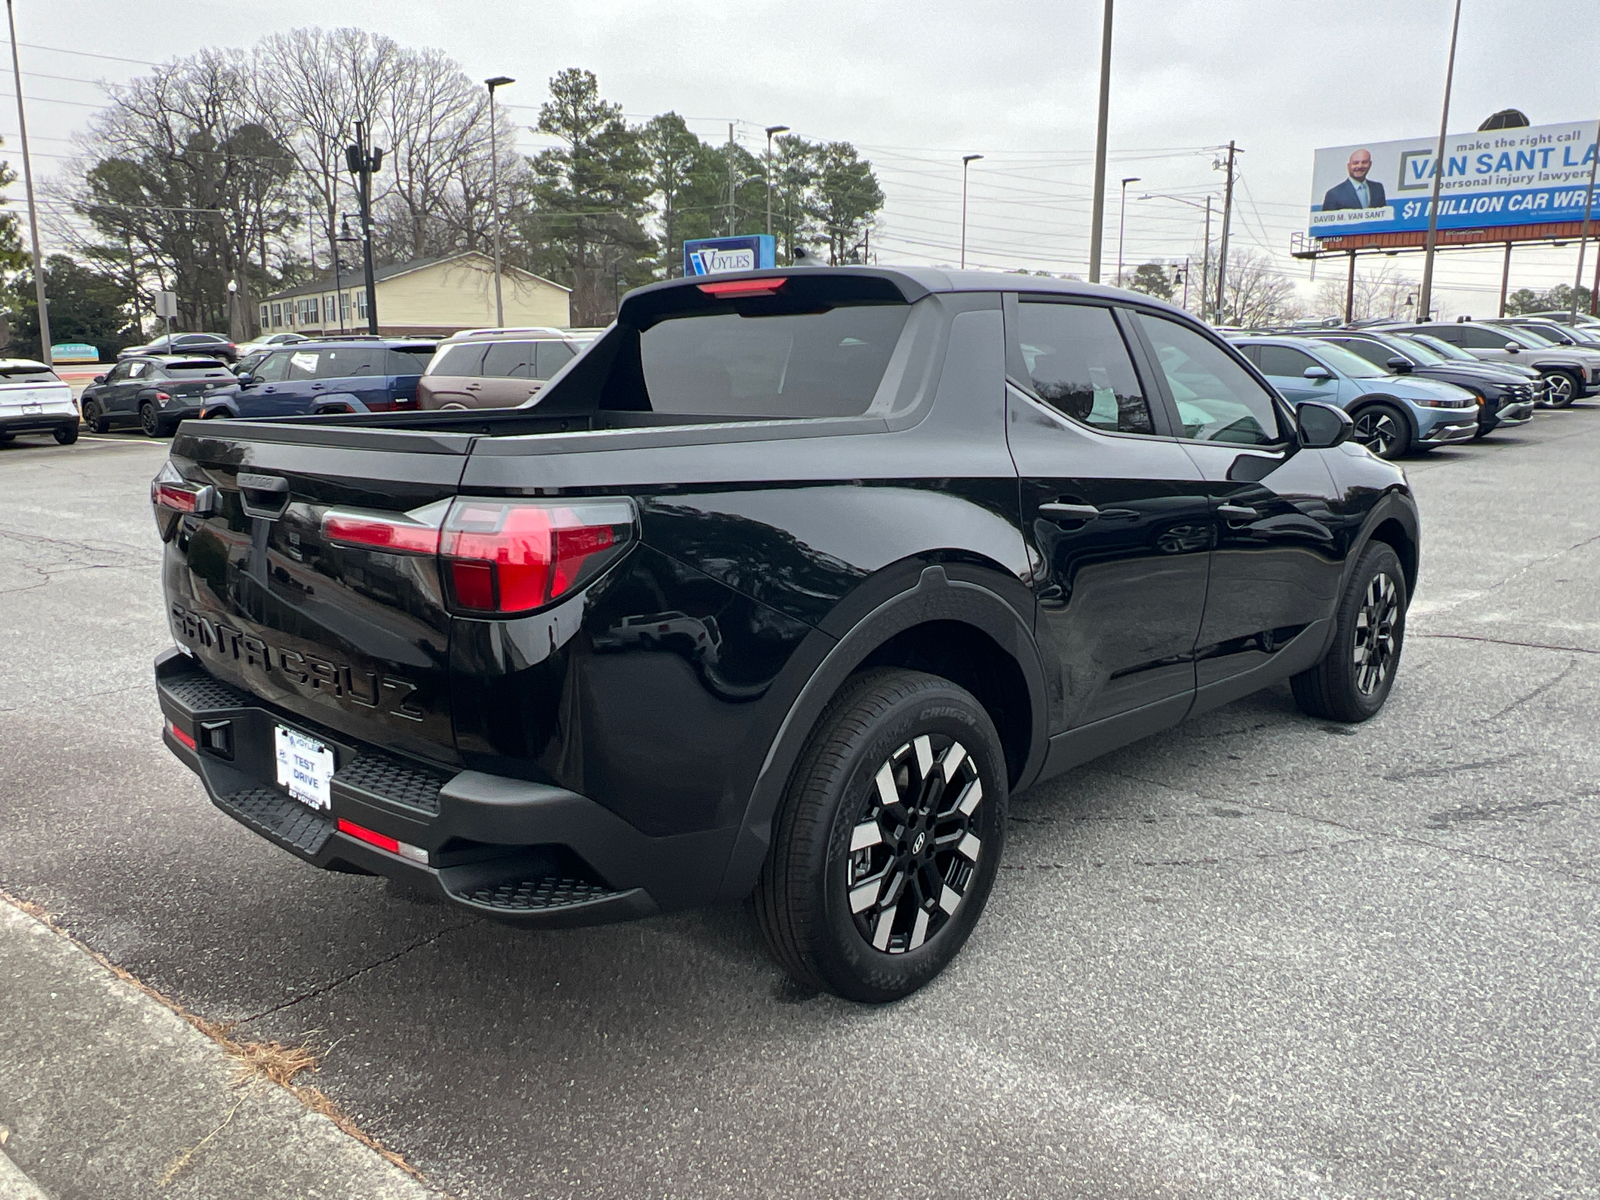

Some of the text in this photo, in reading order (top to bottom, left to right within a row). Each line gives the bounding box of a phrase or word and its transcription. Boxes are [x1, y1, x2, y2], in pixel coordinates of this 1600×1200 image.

[1456, 130, 1581, 152] make the right call
[1411, 155, 1468, 180] VAN
[1475, 147, 1556, 174] SANT
[1495, 173, 1535, 187] injury
[1538, 169, 1593, 182] lawyers
[1313, 214, 1336, 223] DAVID
[1348, 212, 1364, 221] VAN
[1364, 210, 1386, 219] SANT
[1402, 200, 1422, 220] $1
[1424, 196, 1505, 217] MILLION
[1507, 192, 1550, 212] CAR
[700, 251, 749, 274] VOYLES
[279, 647, 424, 723] CRUZ
[293, 754, 315, 772] TEST
[293, 768, 320, 789] DRIVE
